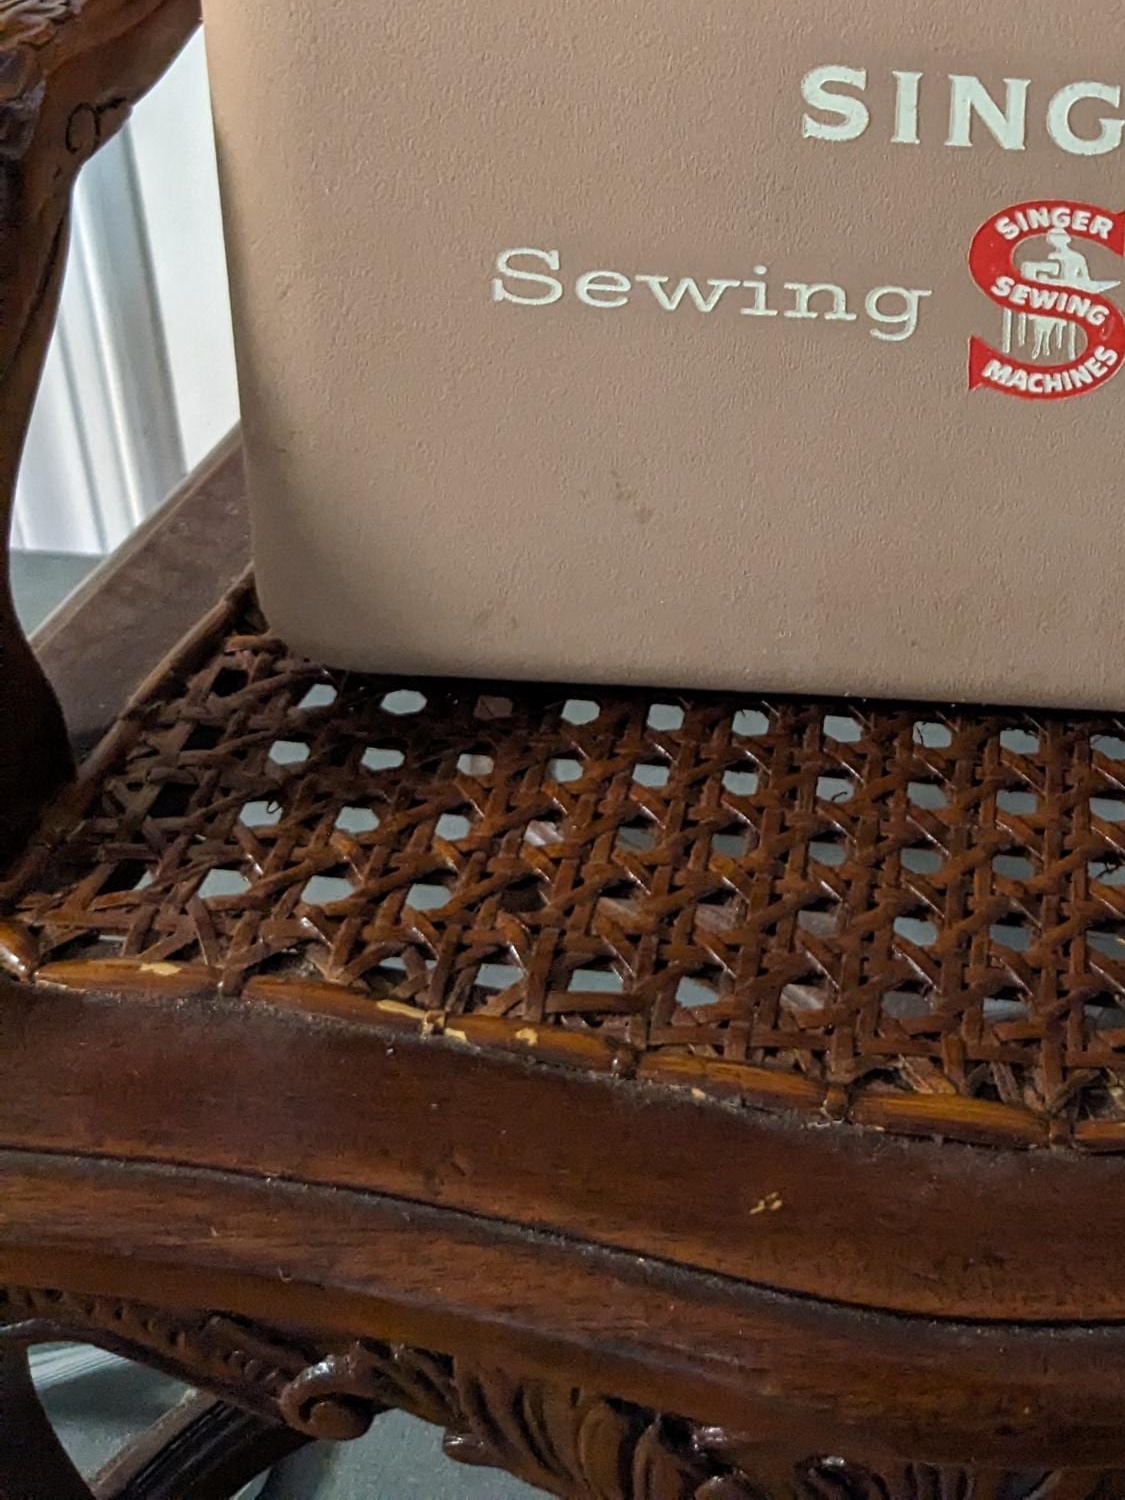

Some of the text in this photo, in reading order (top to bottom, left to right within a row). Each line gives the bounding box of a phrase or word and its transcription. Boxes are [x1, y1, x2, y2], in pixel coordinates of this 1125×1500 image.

[994, 207, 1114, 240] SINGER
[492, 247, 933, 341] Sewing
[991, 276, 1110, 327] SEWING
[981, 345, 1119, 393] MACHINES
